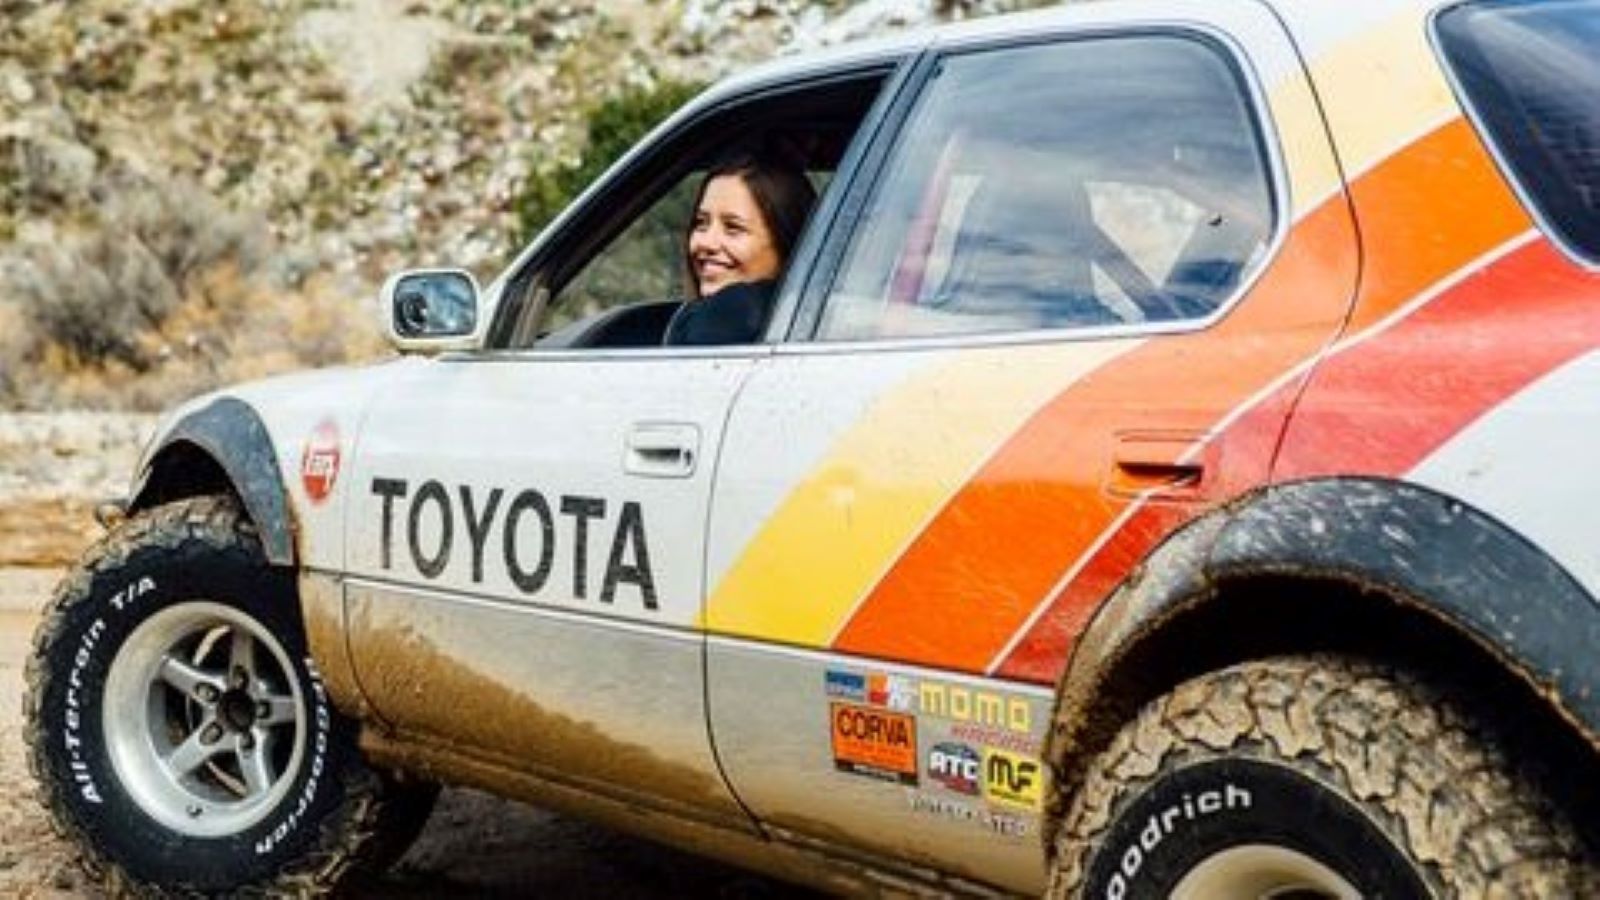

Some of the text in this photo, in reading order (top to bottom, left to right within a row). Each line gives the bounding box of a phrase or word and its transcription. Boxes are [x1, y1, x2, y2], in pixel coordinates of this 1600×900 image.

[371, 476, 658, 610] TOYOTA
[836, 707, 909, 747] CORVA
[929, 751, 979, 780] ATC
